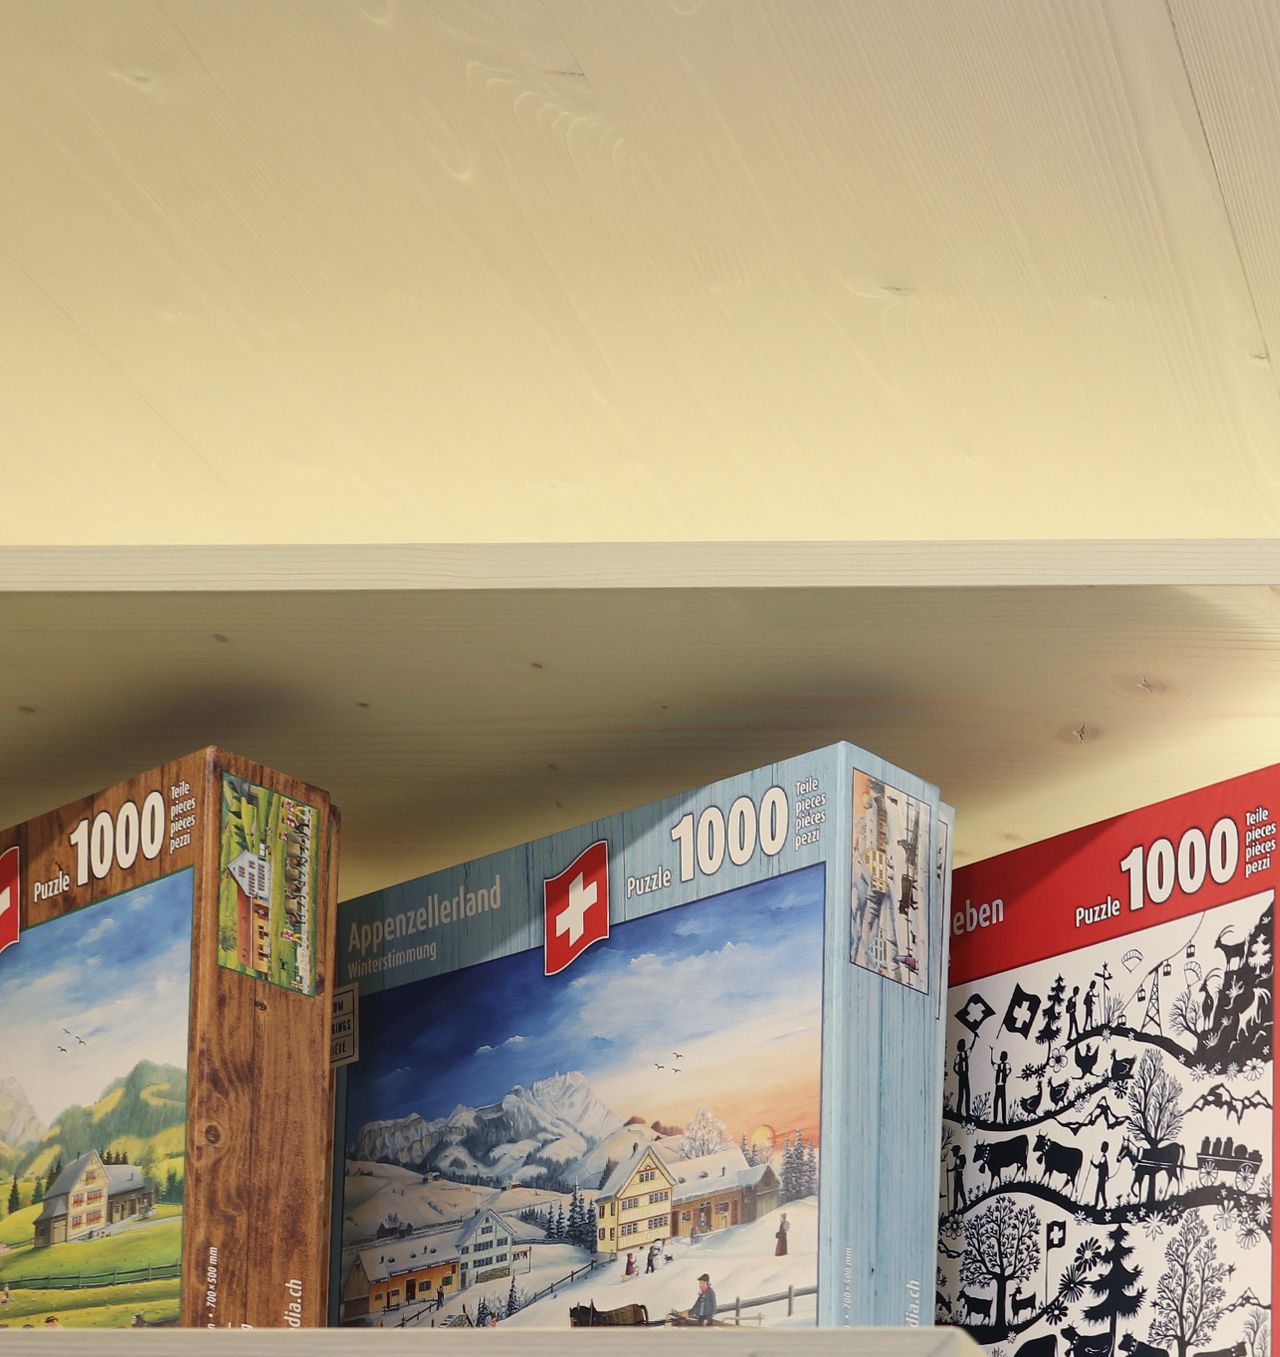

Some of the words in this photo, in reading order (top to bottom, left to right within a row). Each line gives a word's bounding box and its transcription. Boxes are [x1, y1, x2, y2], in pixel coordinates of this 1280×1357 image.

[171, 781, 190, 799] Teile
[796, 776, 819, 796] Teile
[171, 798, 196, 820] pieces
[796, 793, 826, 817] pieces
[1245, 807, 1269, 827] Teile
[170, 814, 196, 837] pièces
[796, 809, 826, 833] pièces
[170, 830, 191, 854] pezzi
[627, 865, 672, 899] Puzzle
[671, 786, 789, 883] 1000
[795, 827, 820, 851] pezzi
[1245, 822, 1277, 846] pieces
[34, 870, 70, 902] Puzzle
[70, 791, 165, 887] 1000
[1245, 838, 1277, 863] pièces
[1076, 896, 1121, 928] Puzzle
[1120, 817, 1239, 911] 1000
[1245, 854, 1271, 878] pezzi
[348, 874, 502, 956] Appenzellerland
[348, 941, 438, 979] Winterstimmung
[209, 1246, 218, 1265] mm
